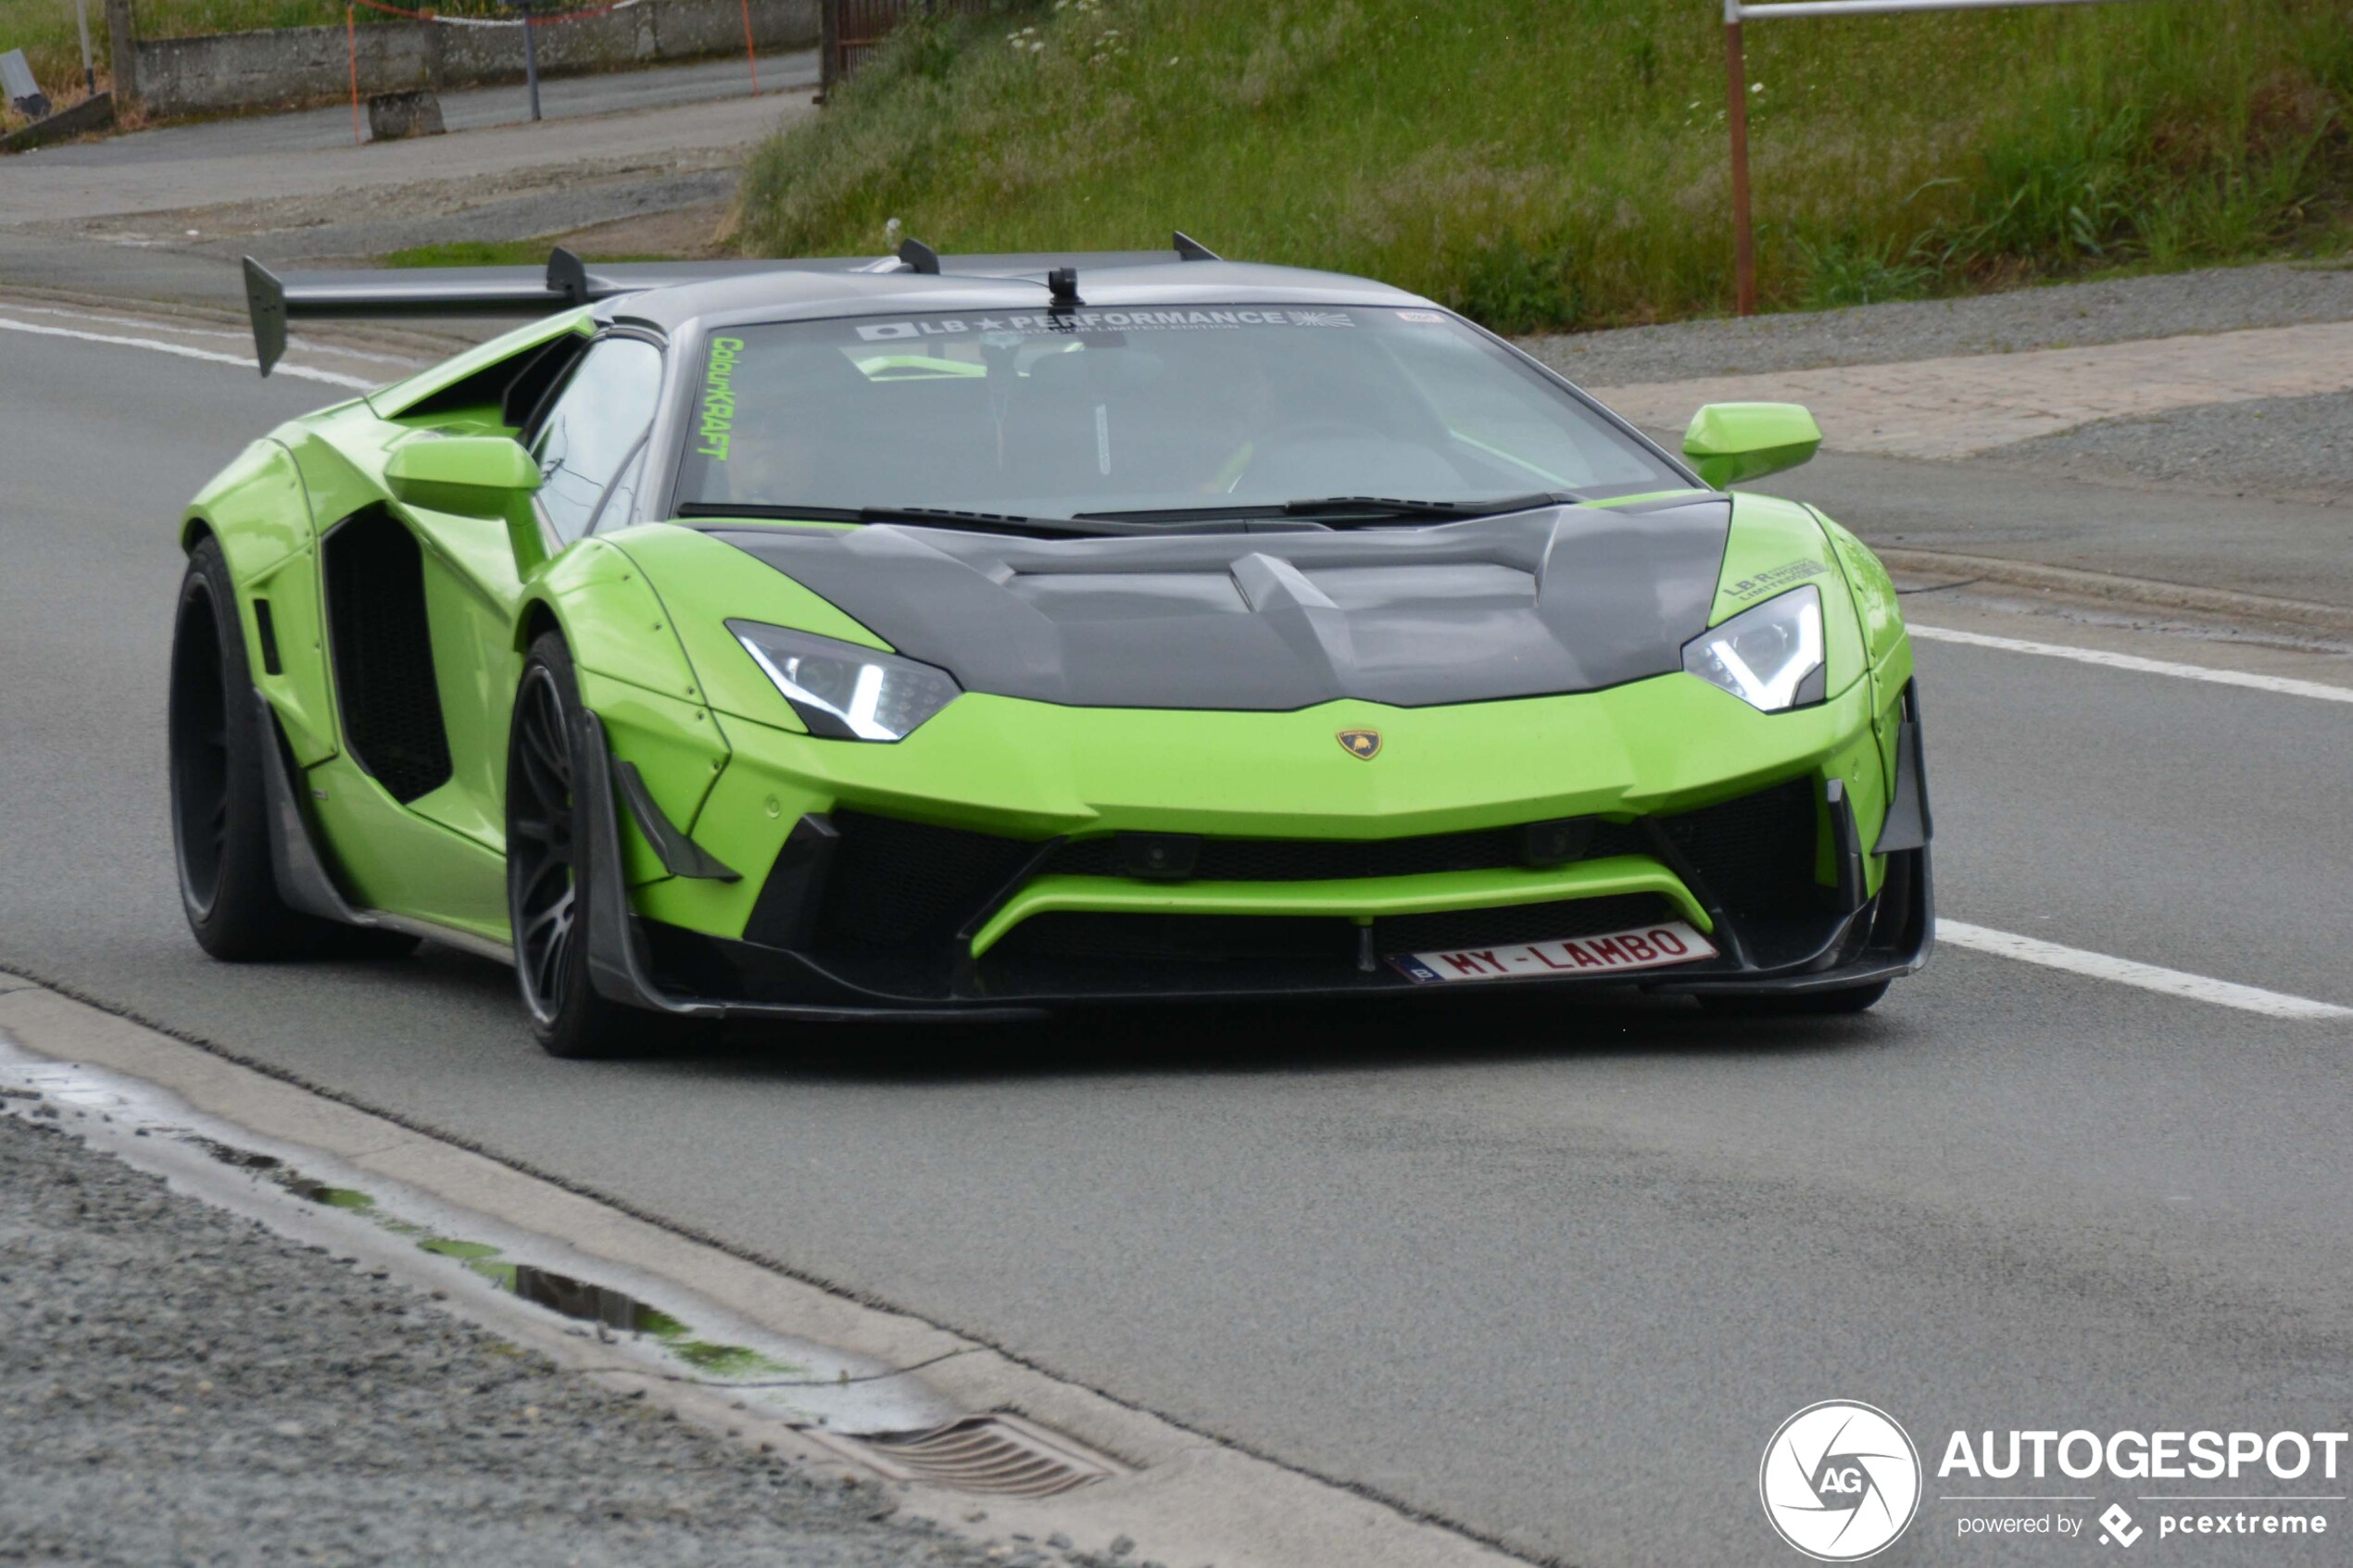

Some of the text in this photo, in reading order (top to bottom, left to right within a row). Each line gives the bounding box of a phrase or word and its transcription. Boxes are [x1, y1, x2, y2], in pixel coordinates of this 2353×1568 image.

[921, 309, 1290, 334] LB PERFORMANCE
[1411, 969, 1434, 978] B
